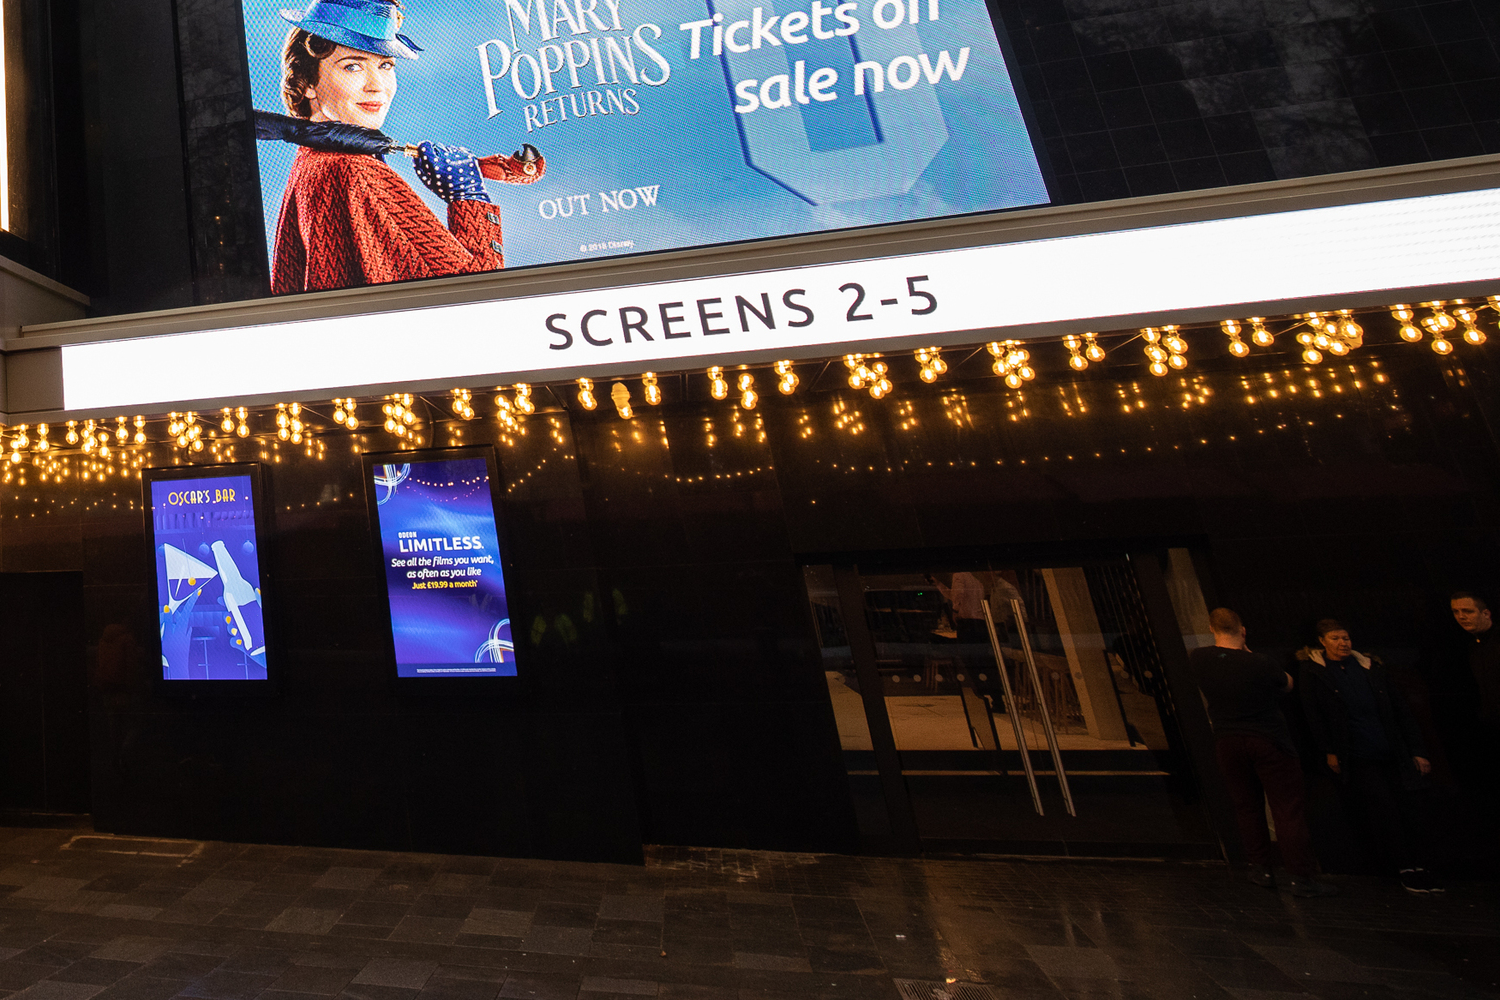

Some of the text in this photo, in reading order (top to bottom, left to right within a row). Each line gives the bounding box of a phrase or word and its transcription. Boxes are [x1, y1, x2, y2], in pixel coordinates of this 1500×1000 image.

[679, 1, 861, 60] Tickets
[475, 23, 671, 120] POPPINS
[734, 47, 971, 114] sale now
[523, 88, 640, 133] RETURNS
[538, 184, 661, 220] OUT NOW
[545, 274, 938, 350] SCREENS 2-5
[168, 488, 236, 506] OSCAR'S BAR
[391, 554, 494, 567] See all the films you want,
[406, 566, 482, 579] as often as you like
